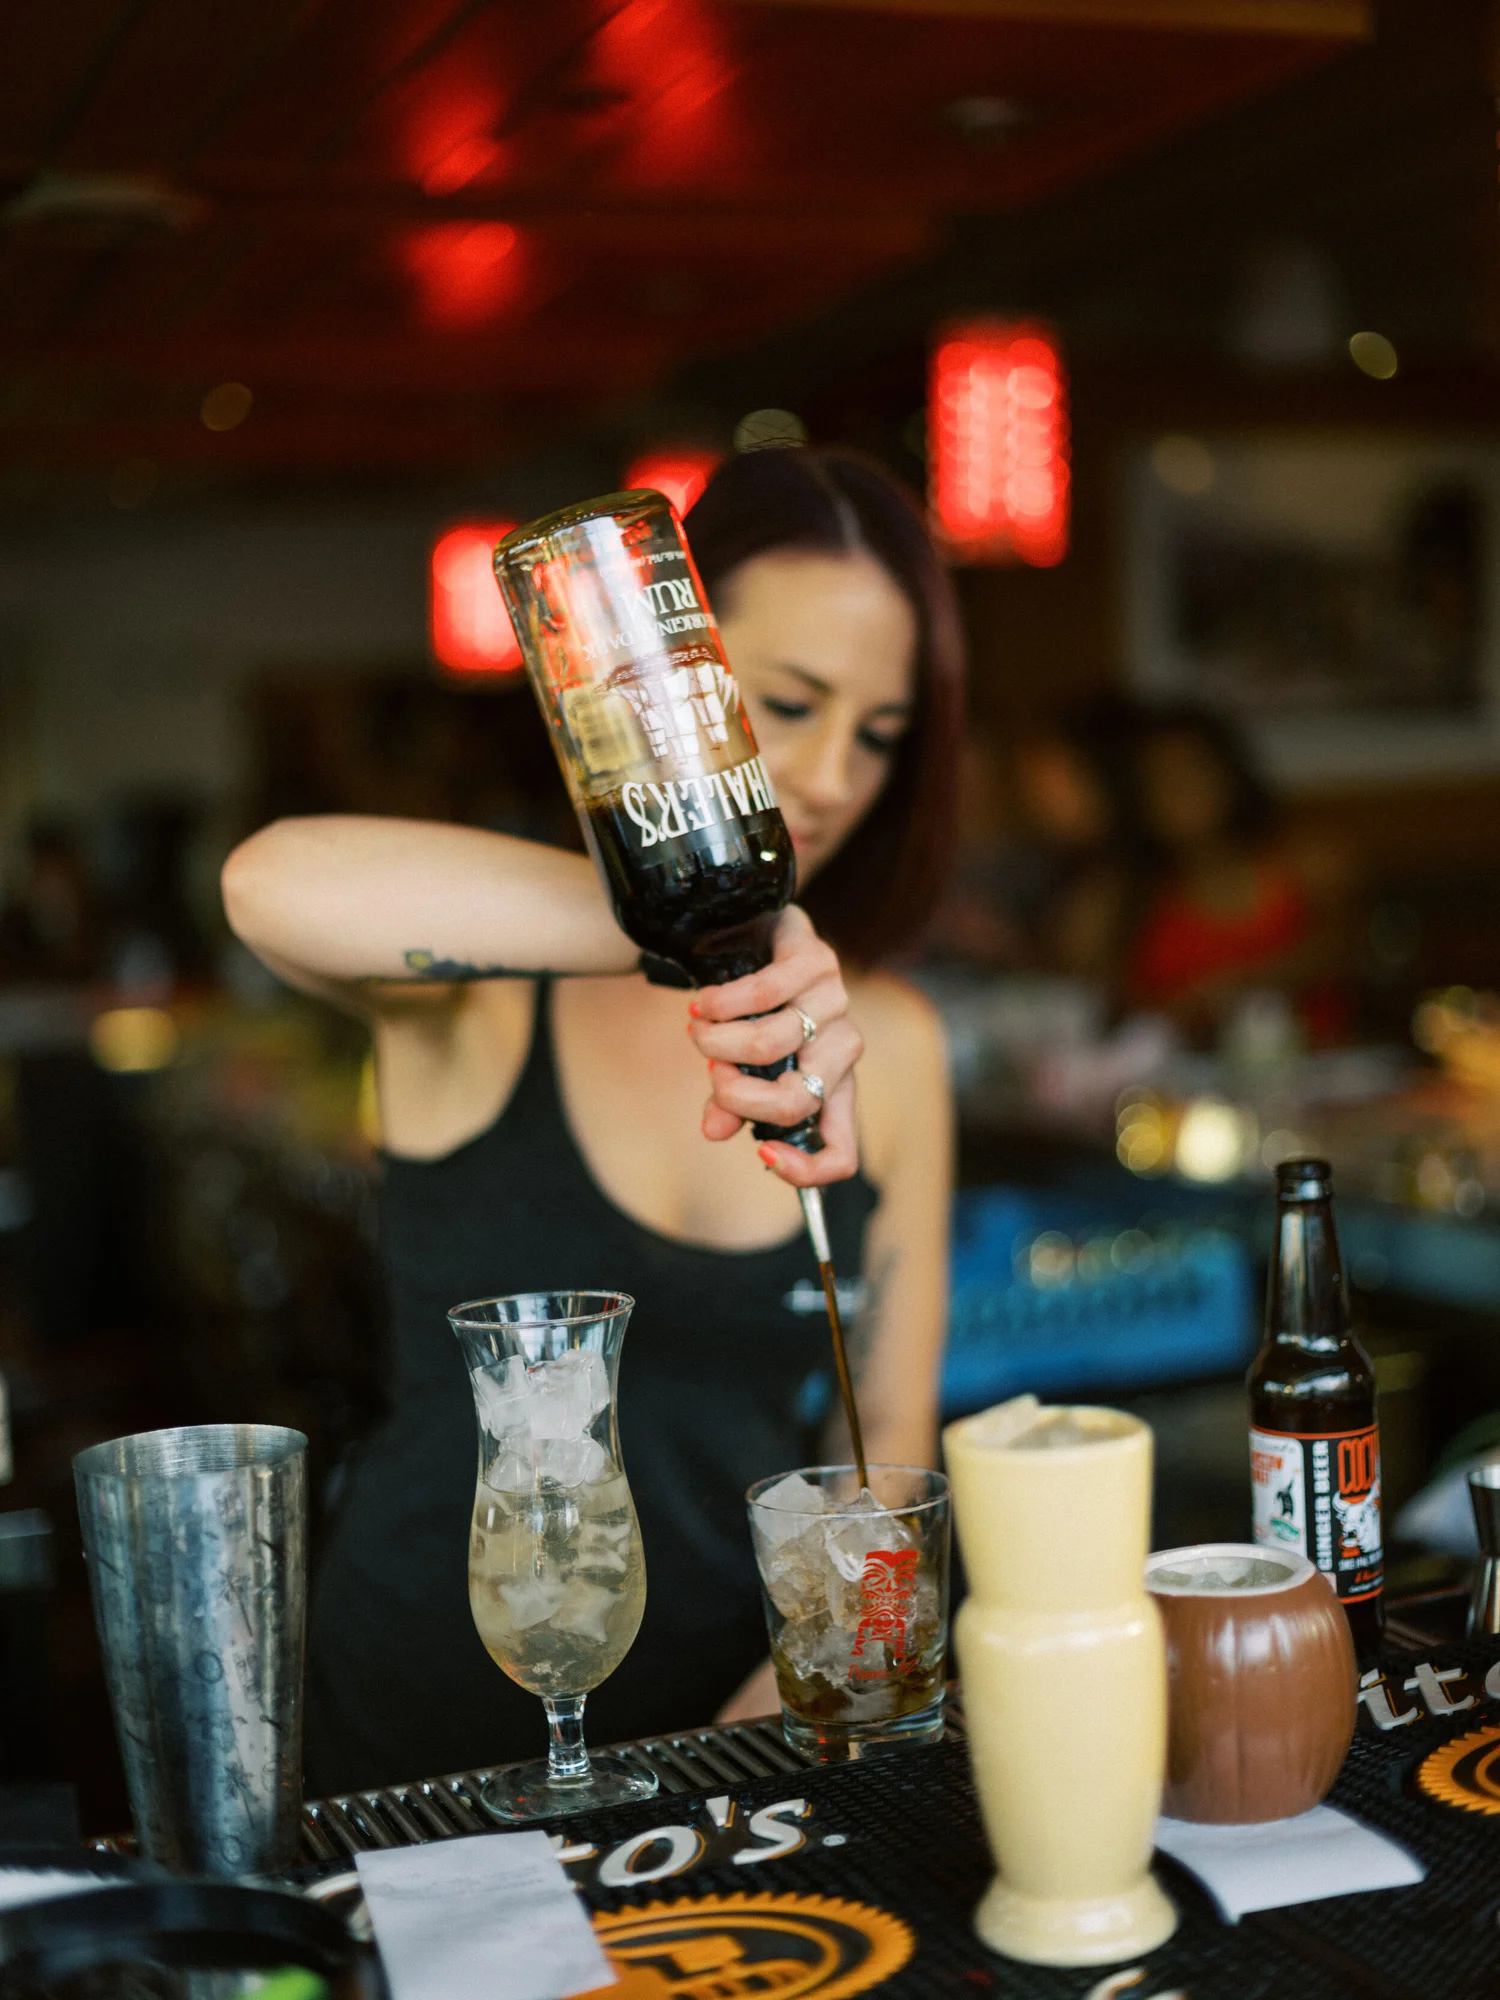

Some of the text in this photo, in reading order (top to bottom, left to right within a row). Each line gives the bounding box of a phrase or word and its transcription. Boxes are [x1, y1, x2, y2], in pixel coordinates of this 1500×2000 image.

[621, 577, 699, 618] RUM
[582, 631, 634, 660] DARK
[1312, 1440, 1333, 1571] GINGER BEER
[1357, 1660, 1500, 1731] it
